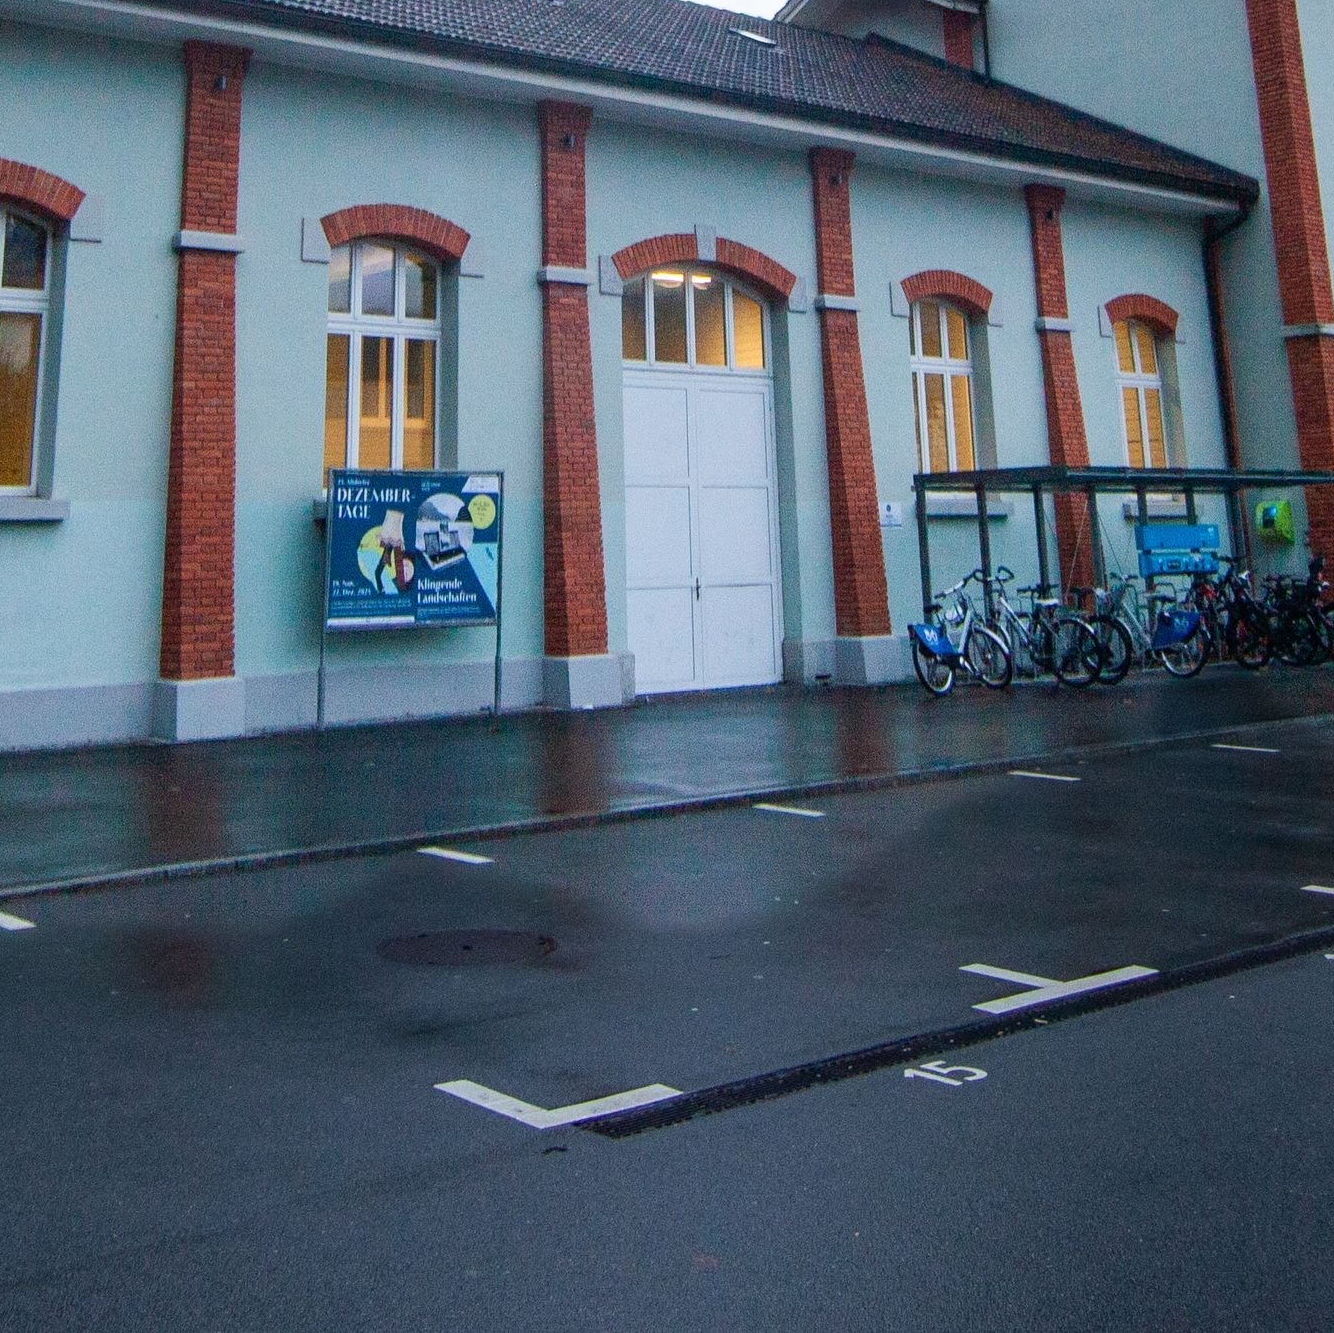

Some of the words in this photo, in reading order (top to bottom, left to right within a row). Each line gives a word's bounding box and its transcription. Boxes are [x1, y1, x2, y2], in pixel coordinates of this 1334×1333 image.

[337, 487, 415, 503] DEZEMBER-
[338, 504, 370, 519] TAGE
[417, 577, 463, 592] Klingende
[417, 590, 477, 604] Landschaften
[904, 1060, 988, 1086] 15
